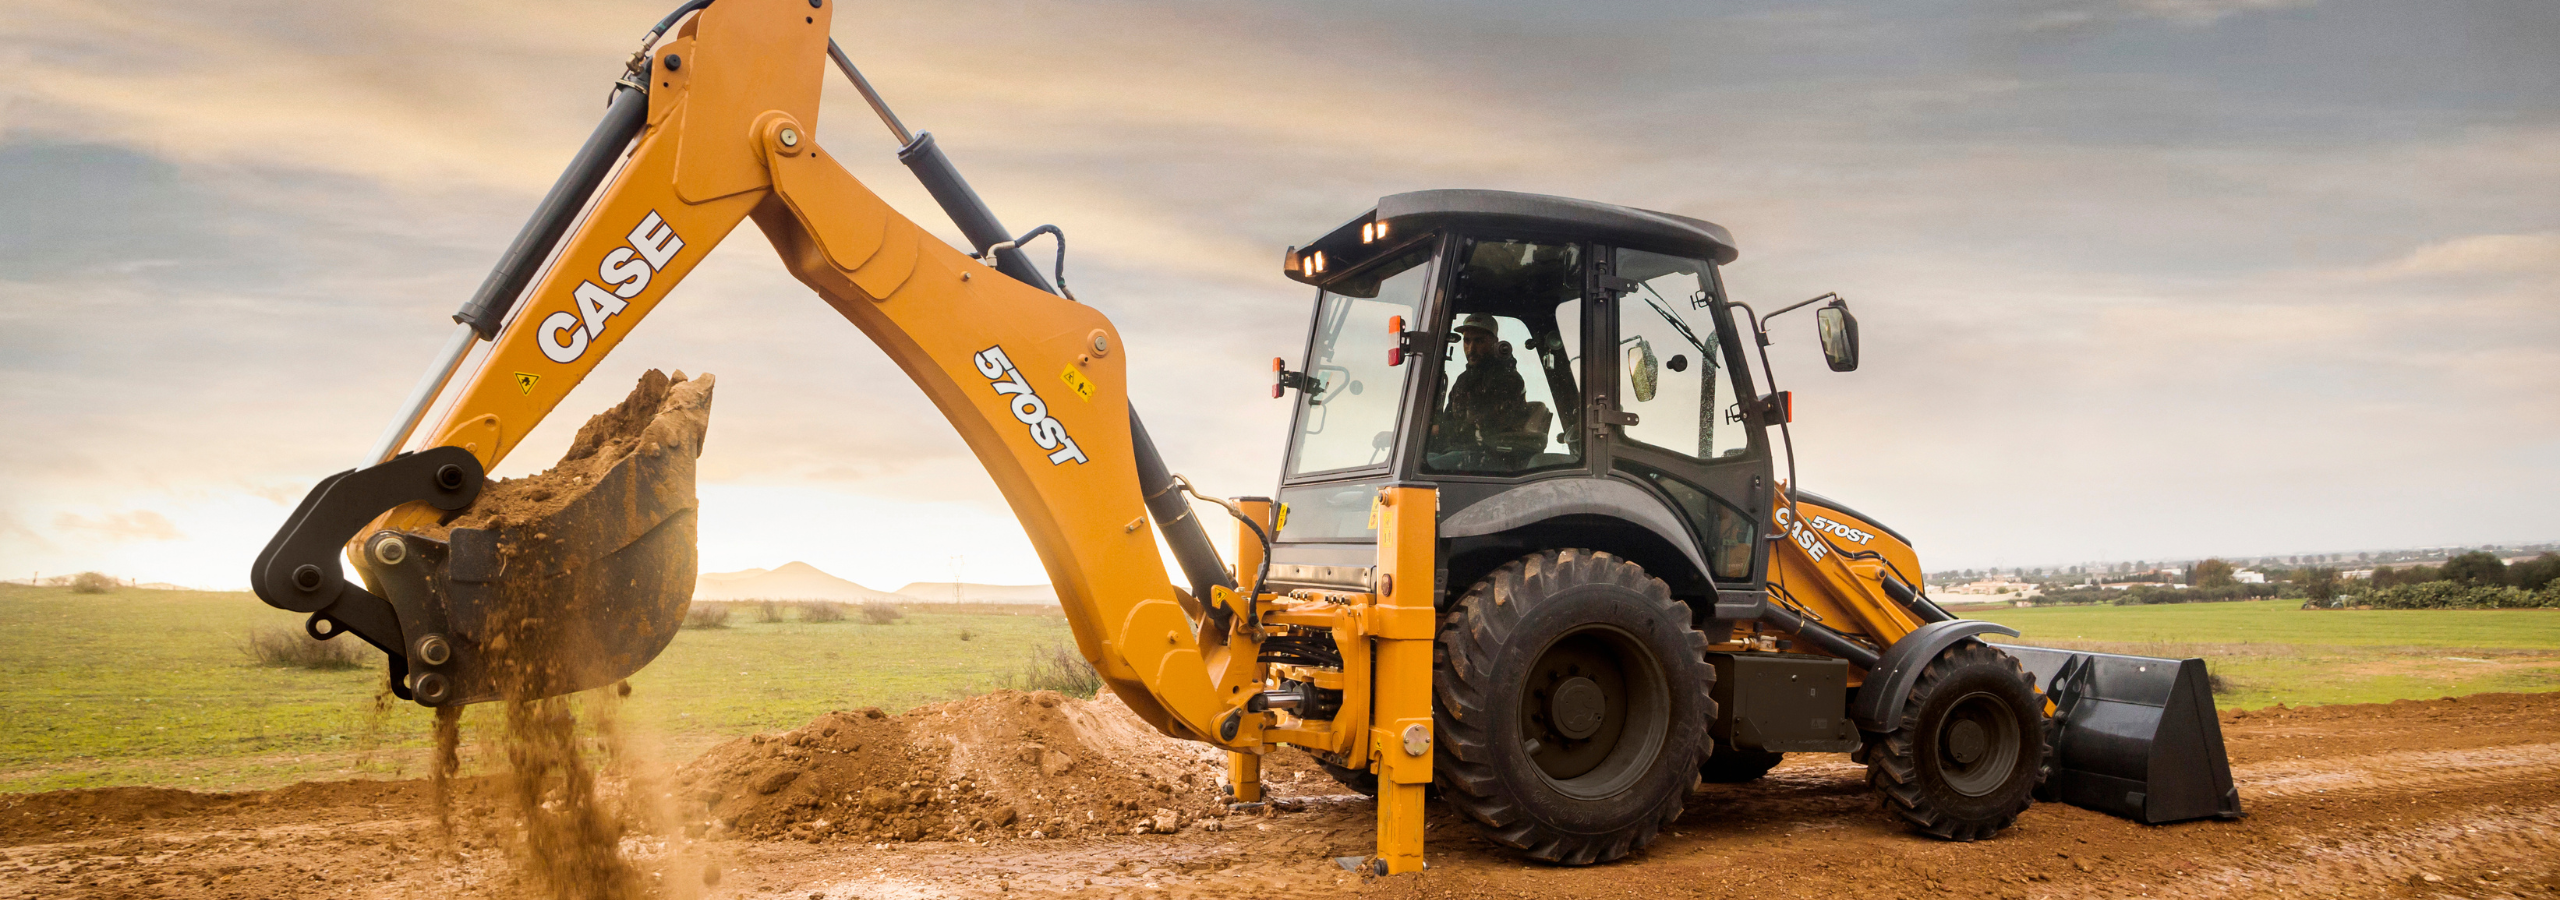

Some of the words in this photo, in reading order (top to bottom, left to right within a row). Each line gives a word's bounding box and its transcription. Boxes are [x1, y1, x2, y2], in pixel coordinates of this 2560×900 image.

[536, 208, 686, 364] CASE
[973, 344, 1090, 466] 570ST
[1775, 507, 1828, 563] CASE
[1811, 515, 1875, 545] 570ST
